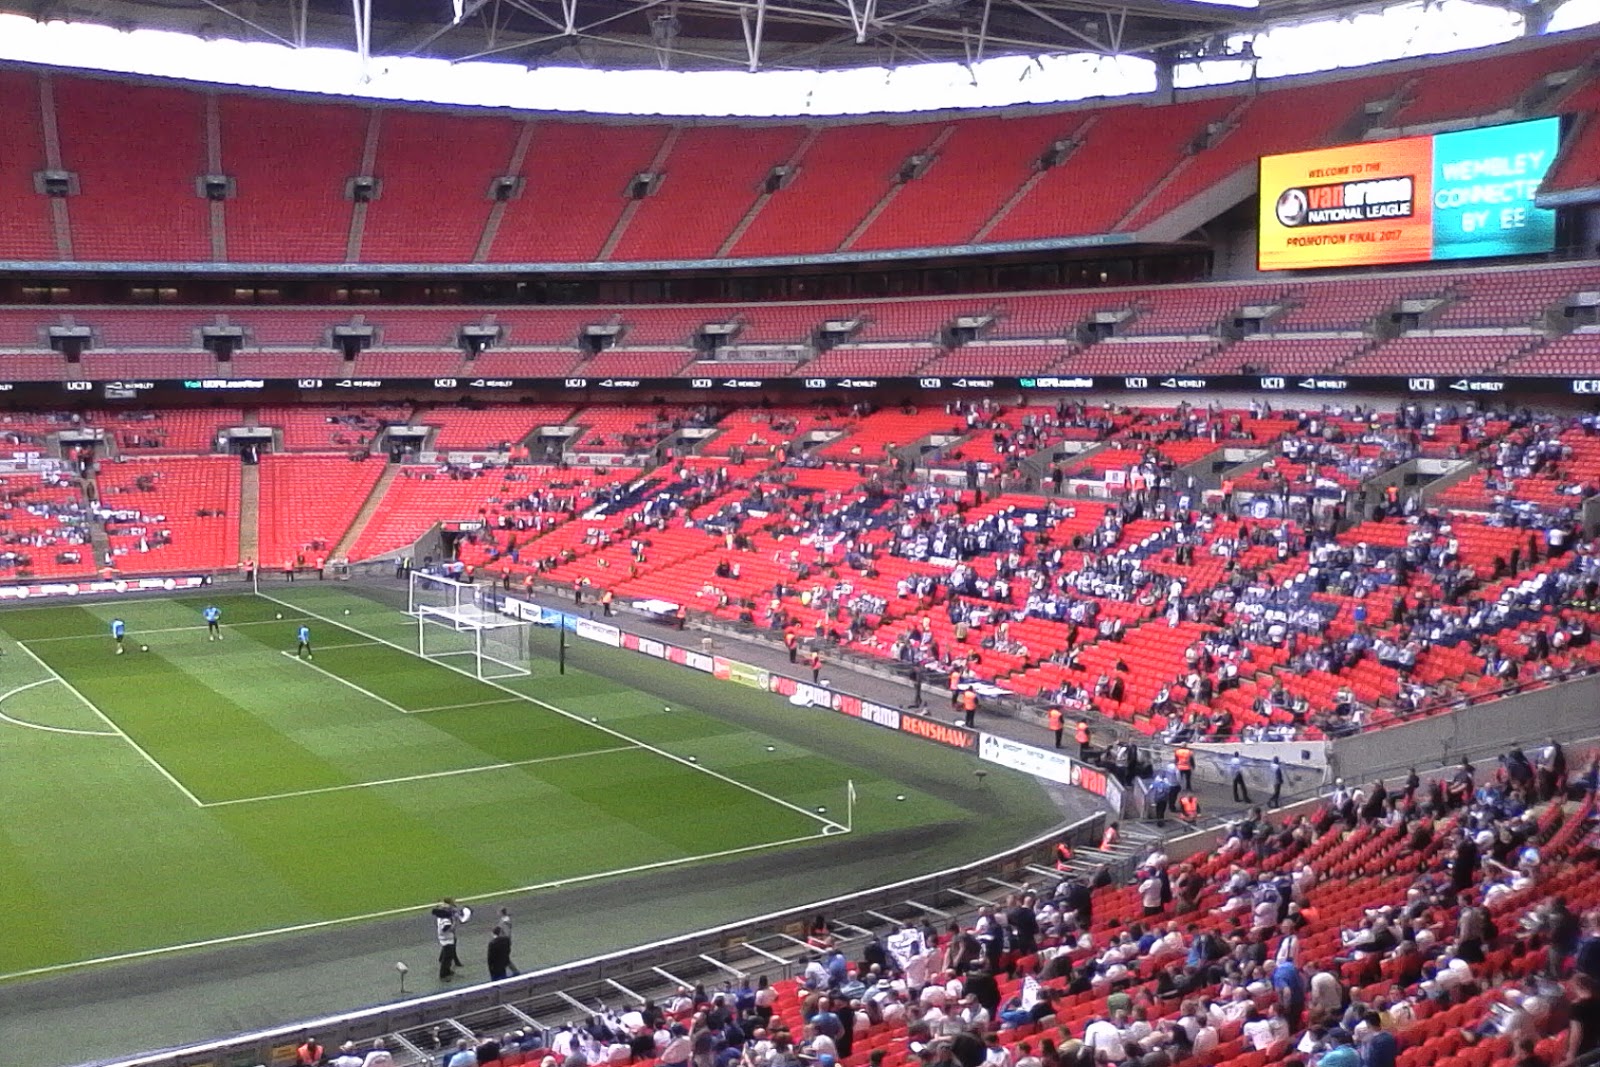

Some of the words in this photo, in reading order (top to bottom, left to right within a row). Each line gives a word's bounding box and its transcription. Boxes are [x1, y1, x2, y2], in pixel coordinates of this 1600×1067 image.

[1308, 165, 1349, 178] WELCOME
[1351, 163, 1363, 174] TO
[1365, 162, 1381, 172] THE
[1442, 150, 1545, 181] WEMBLEY
[1434, 180, 1542, 210] CONNECTE
[1308, 207, 1364, 223] NATIONAL
[1366, 202, 1411, 219] LEAGUE
[1462, 209, 1490, 232] BY
[1500, 206, 1526, 230] EE
[1287, 233, 1347, 247] PROMOTION
[1349, 231, 1376, 243] FINAL
[1381, 229, 1402, 241] 2017
[902, 715, 967, 748] RENISHAW
